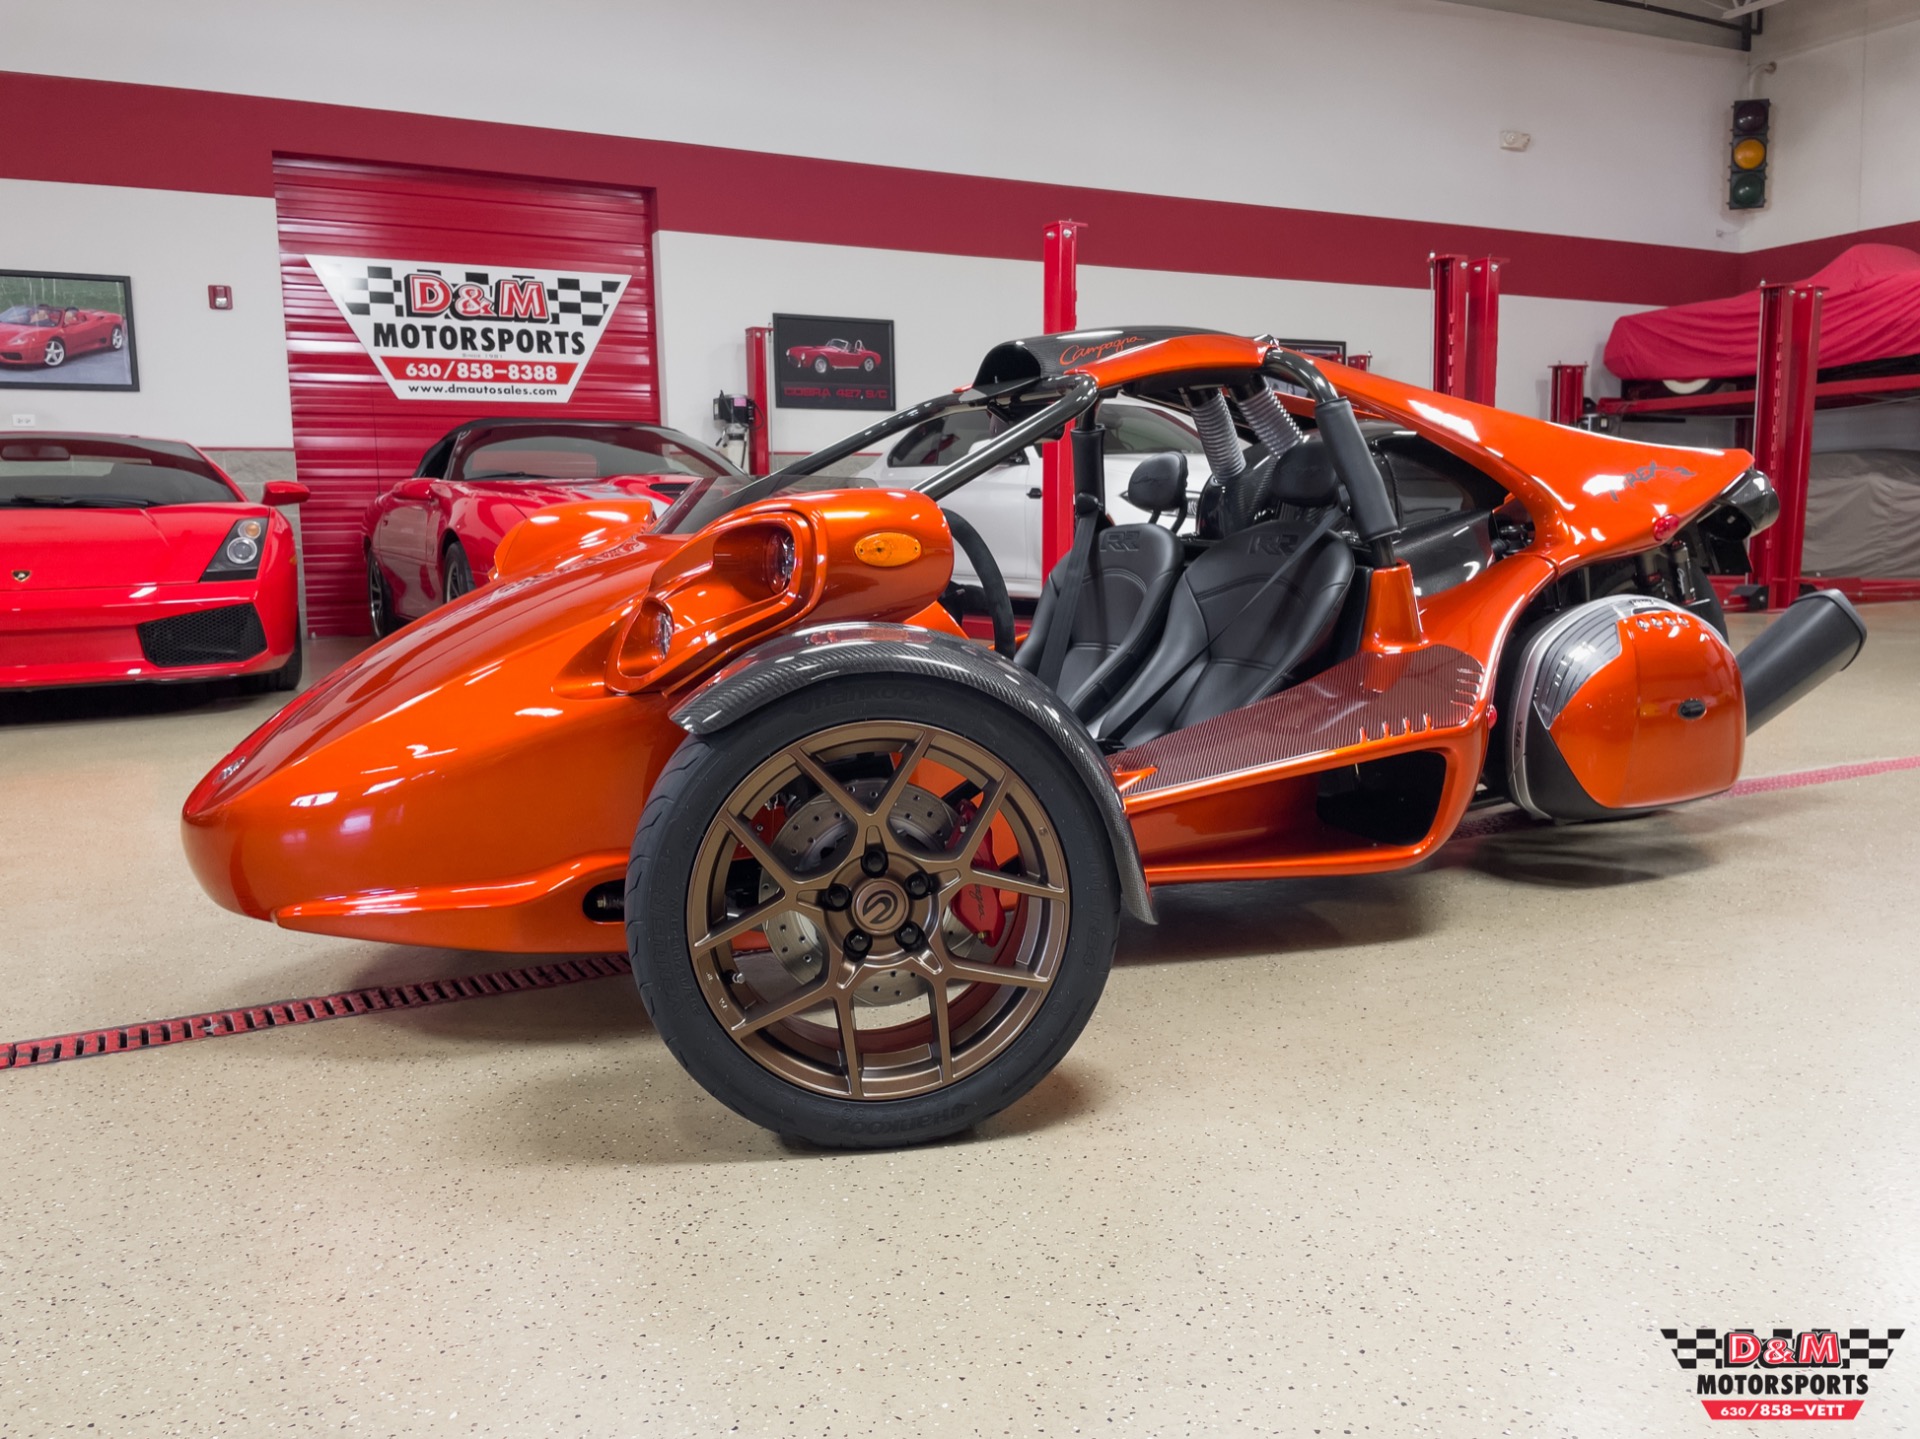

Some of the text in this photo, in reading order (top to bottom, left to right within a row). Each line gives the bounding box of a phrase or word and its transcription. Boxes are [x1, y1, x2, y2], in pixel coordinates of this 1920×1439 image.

[405, 273, 549, 323] D&M
[373, 322, 586, 355] MOTORSPORTS
[405, 361, 557, 381] 630/858-8388
[408, 384, 557, 396] www.dmautosales.com
